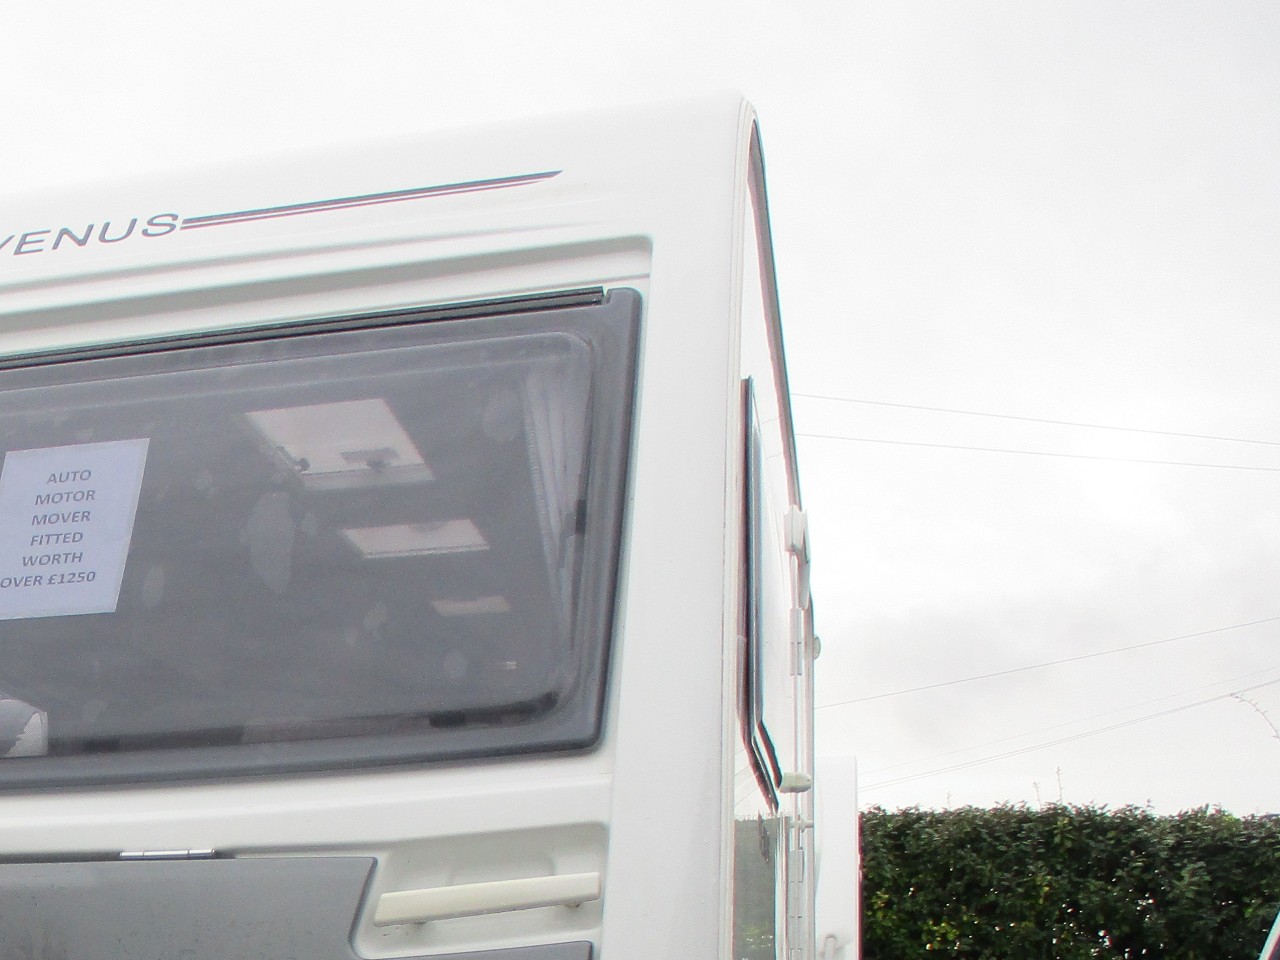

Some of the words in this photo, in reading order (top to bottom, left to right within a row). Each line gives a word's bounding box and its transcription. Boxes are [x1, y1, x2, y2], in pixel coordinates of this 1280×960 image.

[46, 469, 92, 485] AUTO
[34, 489, 96, 506] MOTOR
[31, 510, 91, 526] MOVER
[30, 531, 84, 546] FITTED
[22, 552, 83, 567] WORTH
[0, 574, 43, 589] OVER
[47, 571, 96, 586] £1250
